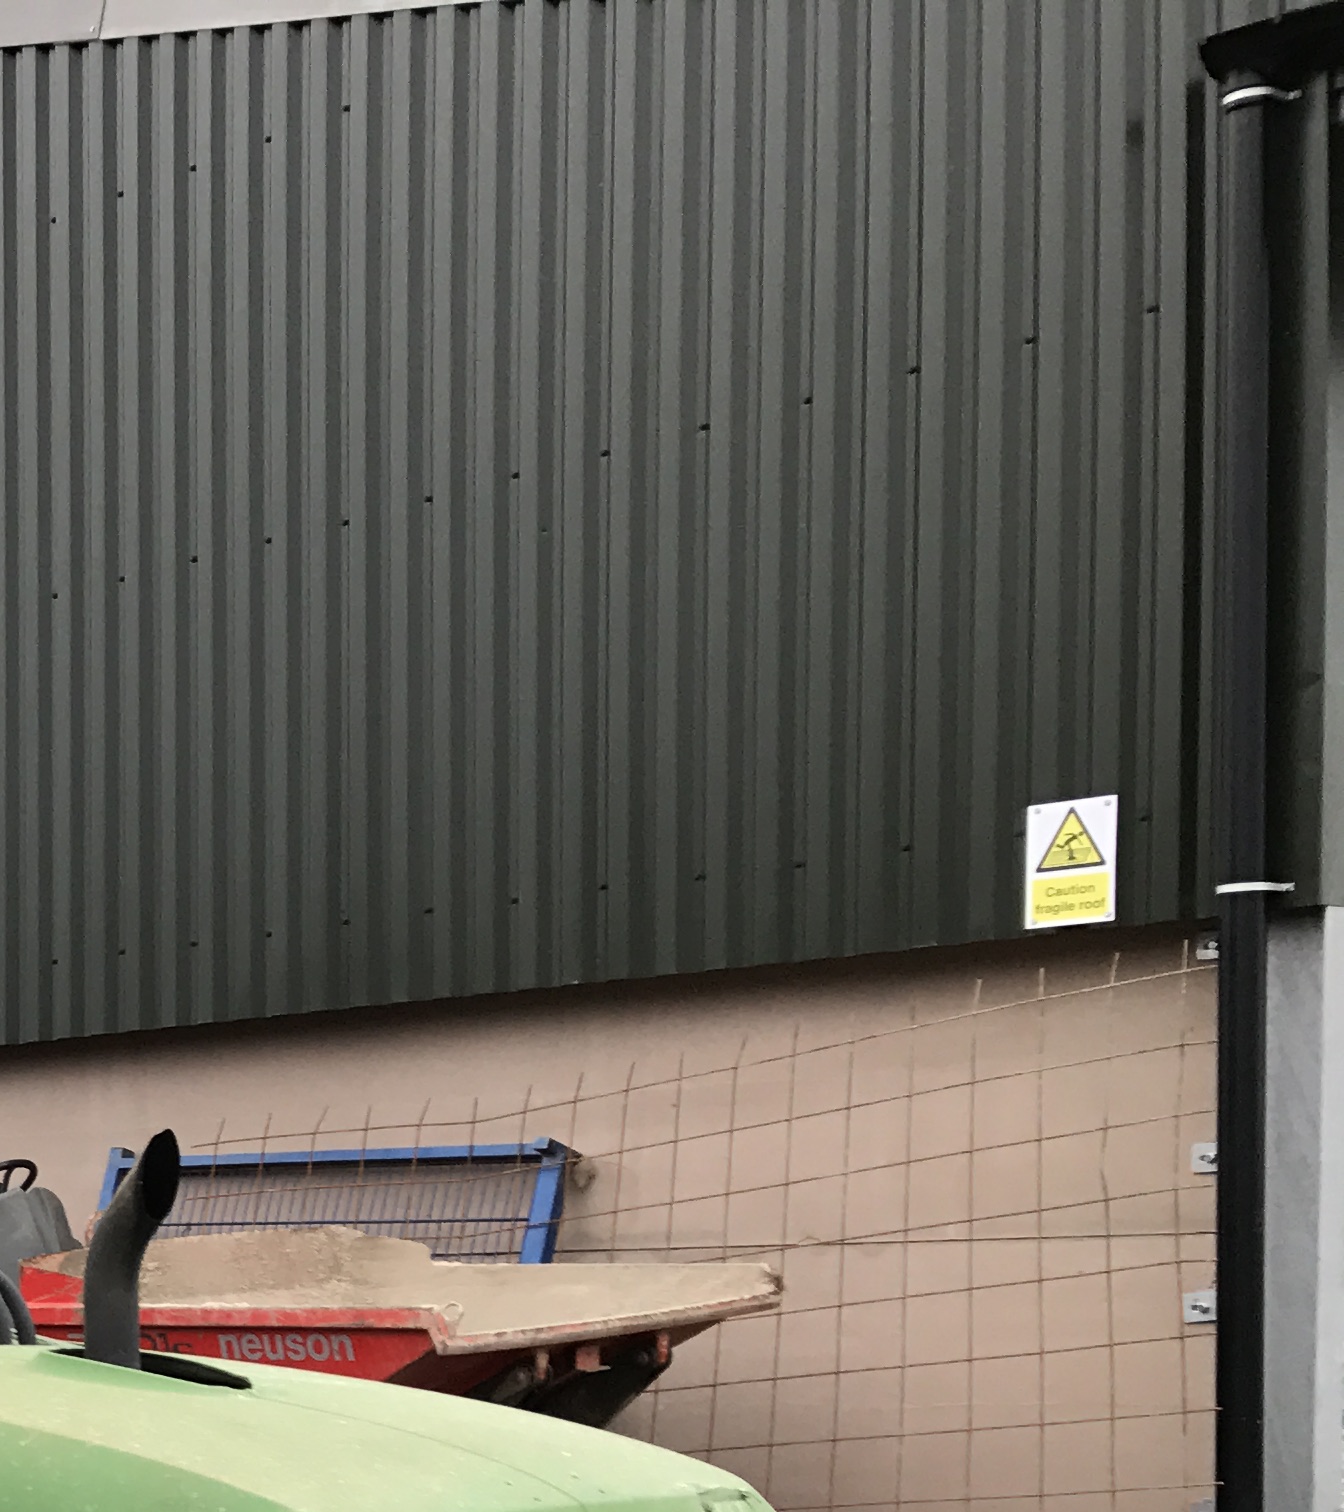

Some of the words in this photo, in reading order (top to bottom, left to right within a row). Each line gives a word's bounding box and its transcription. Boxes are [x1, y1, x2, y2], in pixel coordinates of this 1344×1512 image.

[1046, 885, 1095, 898] Caution
[1035, 901, 1076, 916] fragile
[1078, 897, 1106, 910] roof
[217, 1332, 355, 1362] neuson
